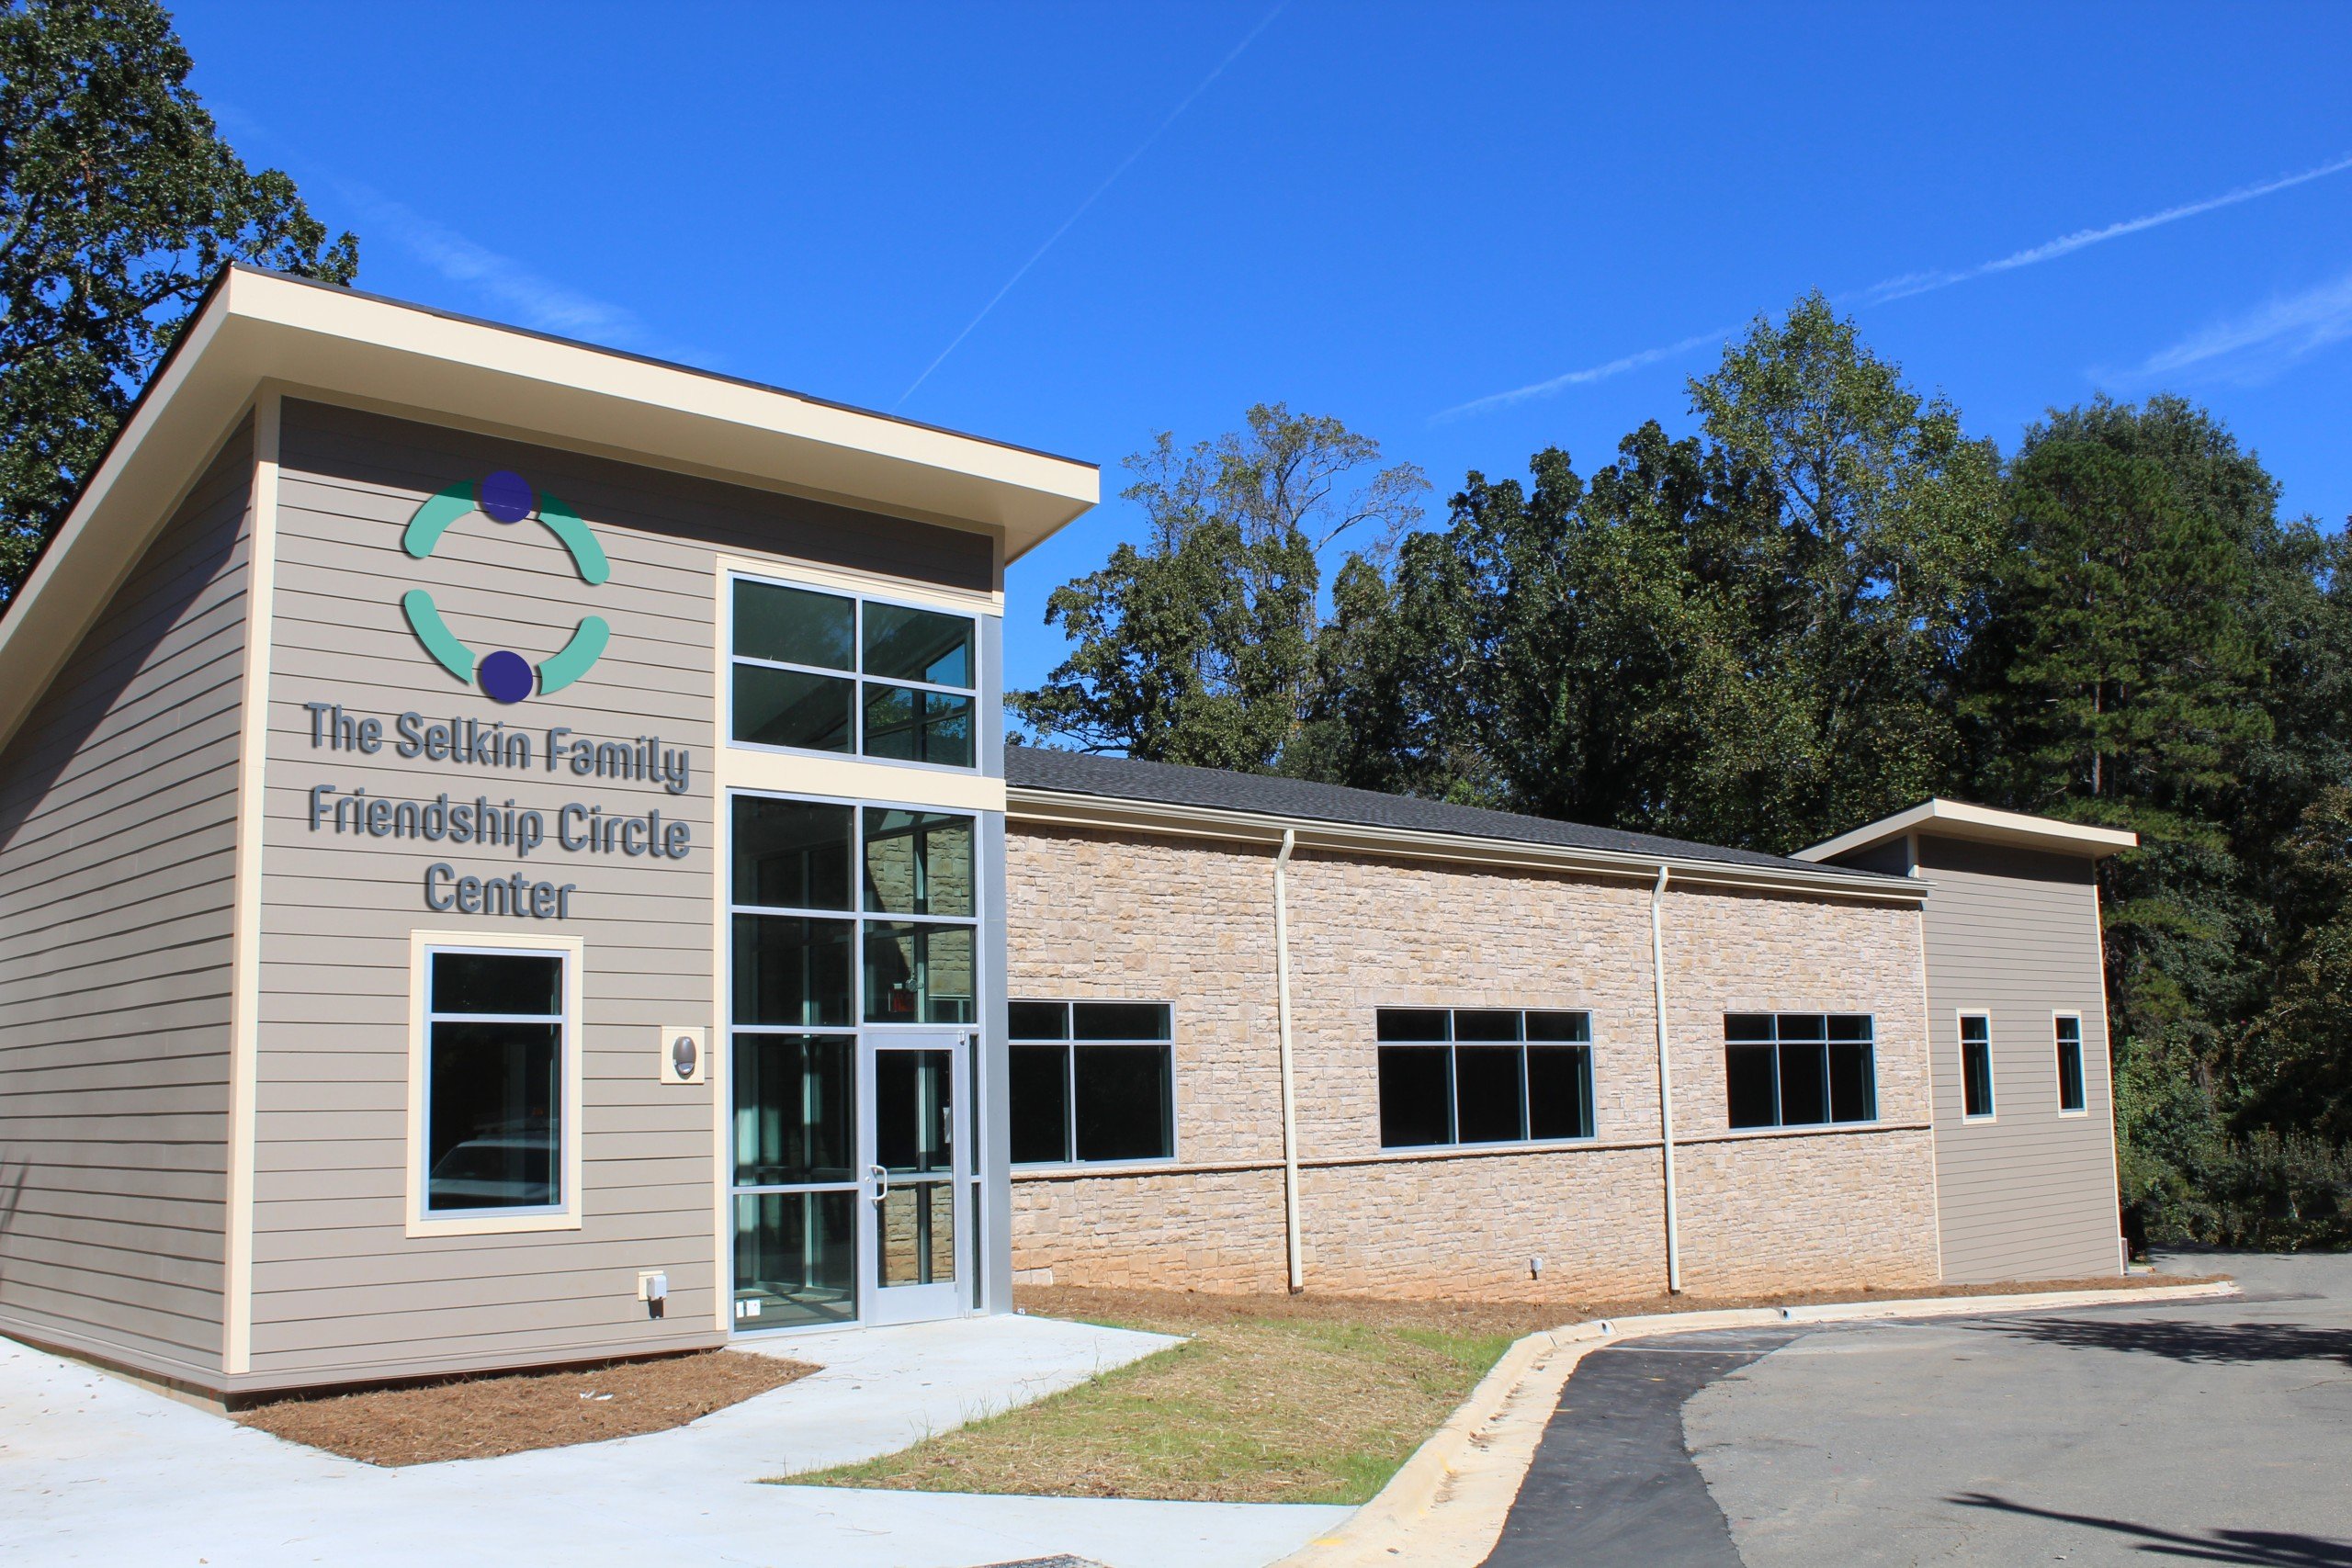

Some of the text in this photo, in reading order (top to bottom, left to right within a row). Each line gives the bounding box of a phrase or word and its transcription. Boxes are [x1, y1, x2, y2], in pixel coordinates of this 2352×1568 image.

[307, 701, 690, 795] The Selkin Family
[310, 784, 691, 859] Friendship Circle
[426, 862, 577, 919] Center
